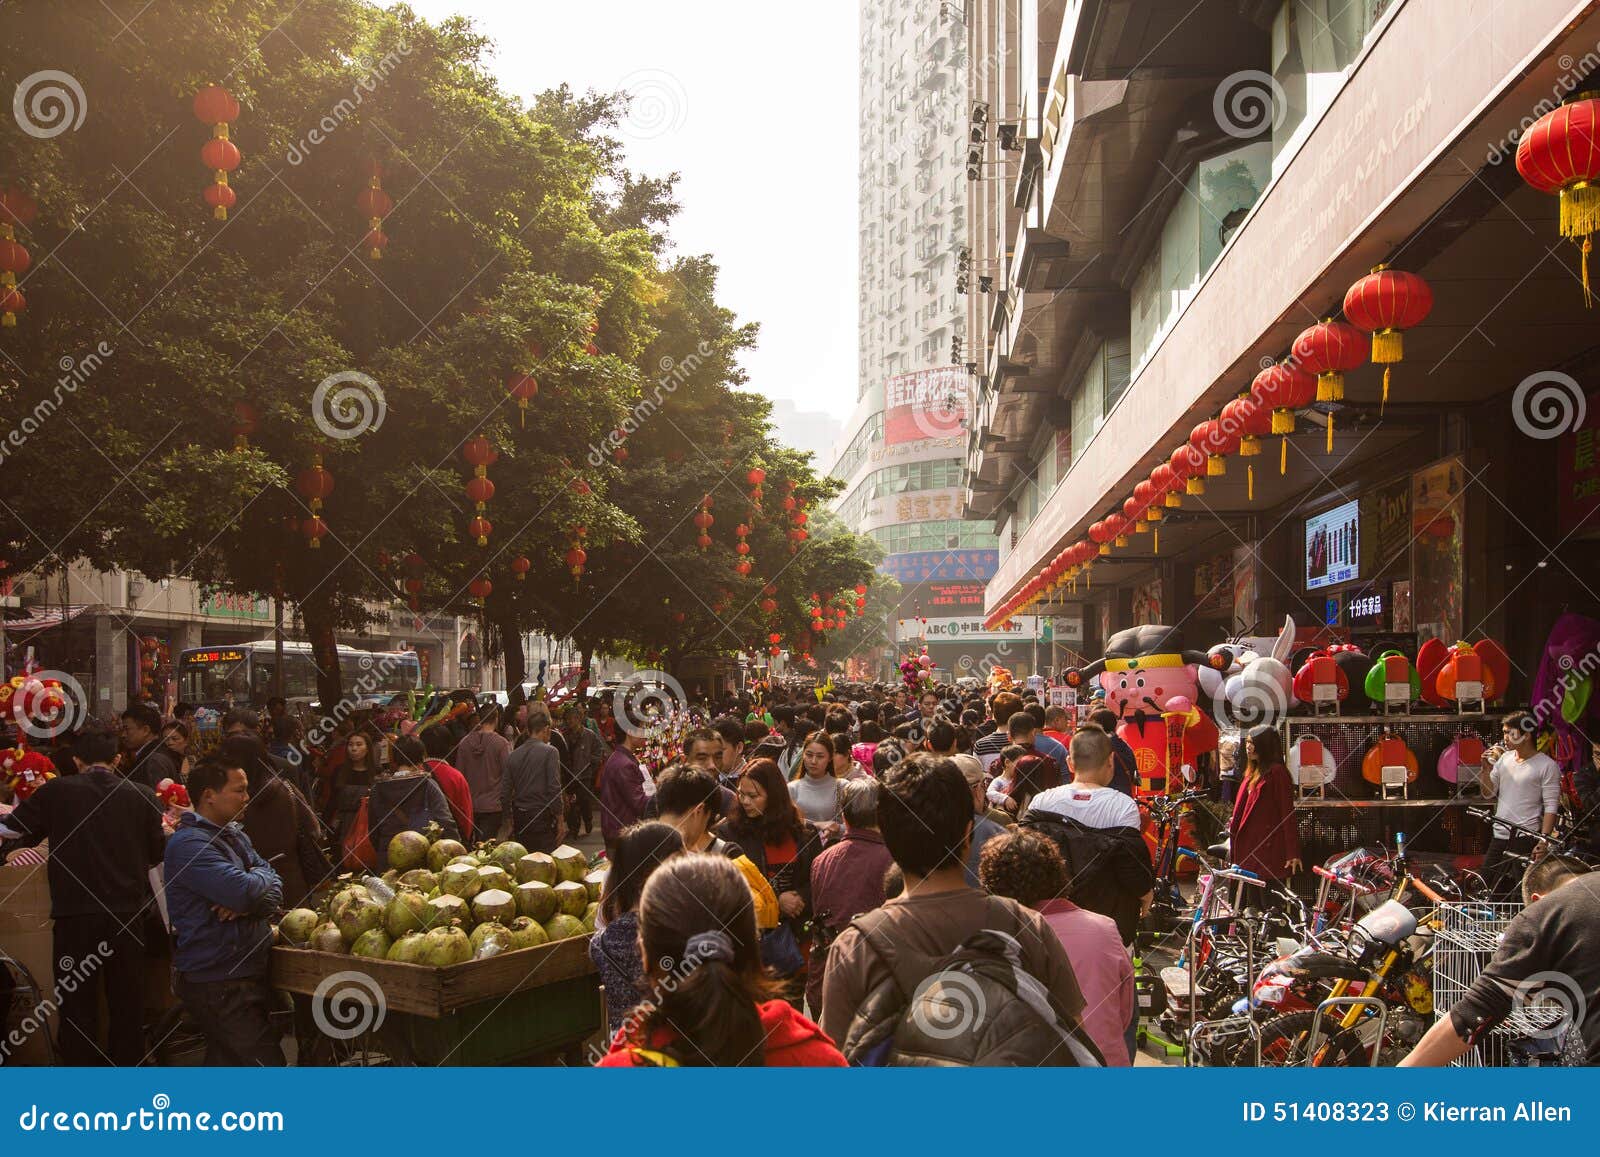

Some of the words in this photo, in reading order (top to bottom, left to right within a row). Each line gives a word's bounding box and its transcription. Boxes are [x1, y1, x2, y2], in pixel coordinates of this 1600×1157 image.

[1349, 595, 1381, 618] 十分乐家品
[926, 624, 948, 634] ABC
